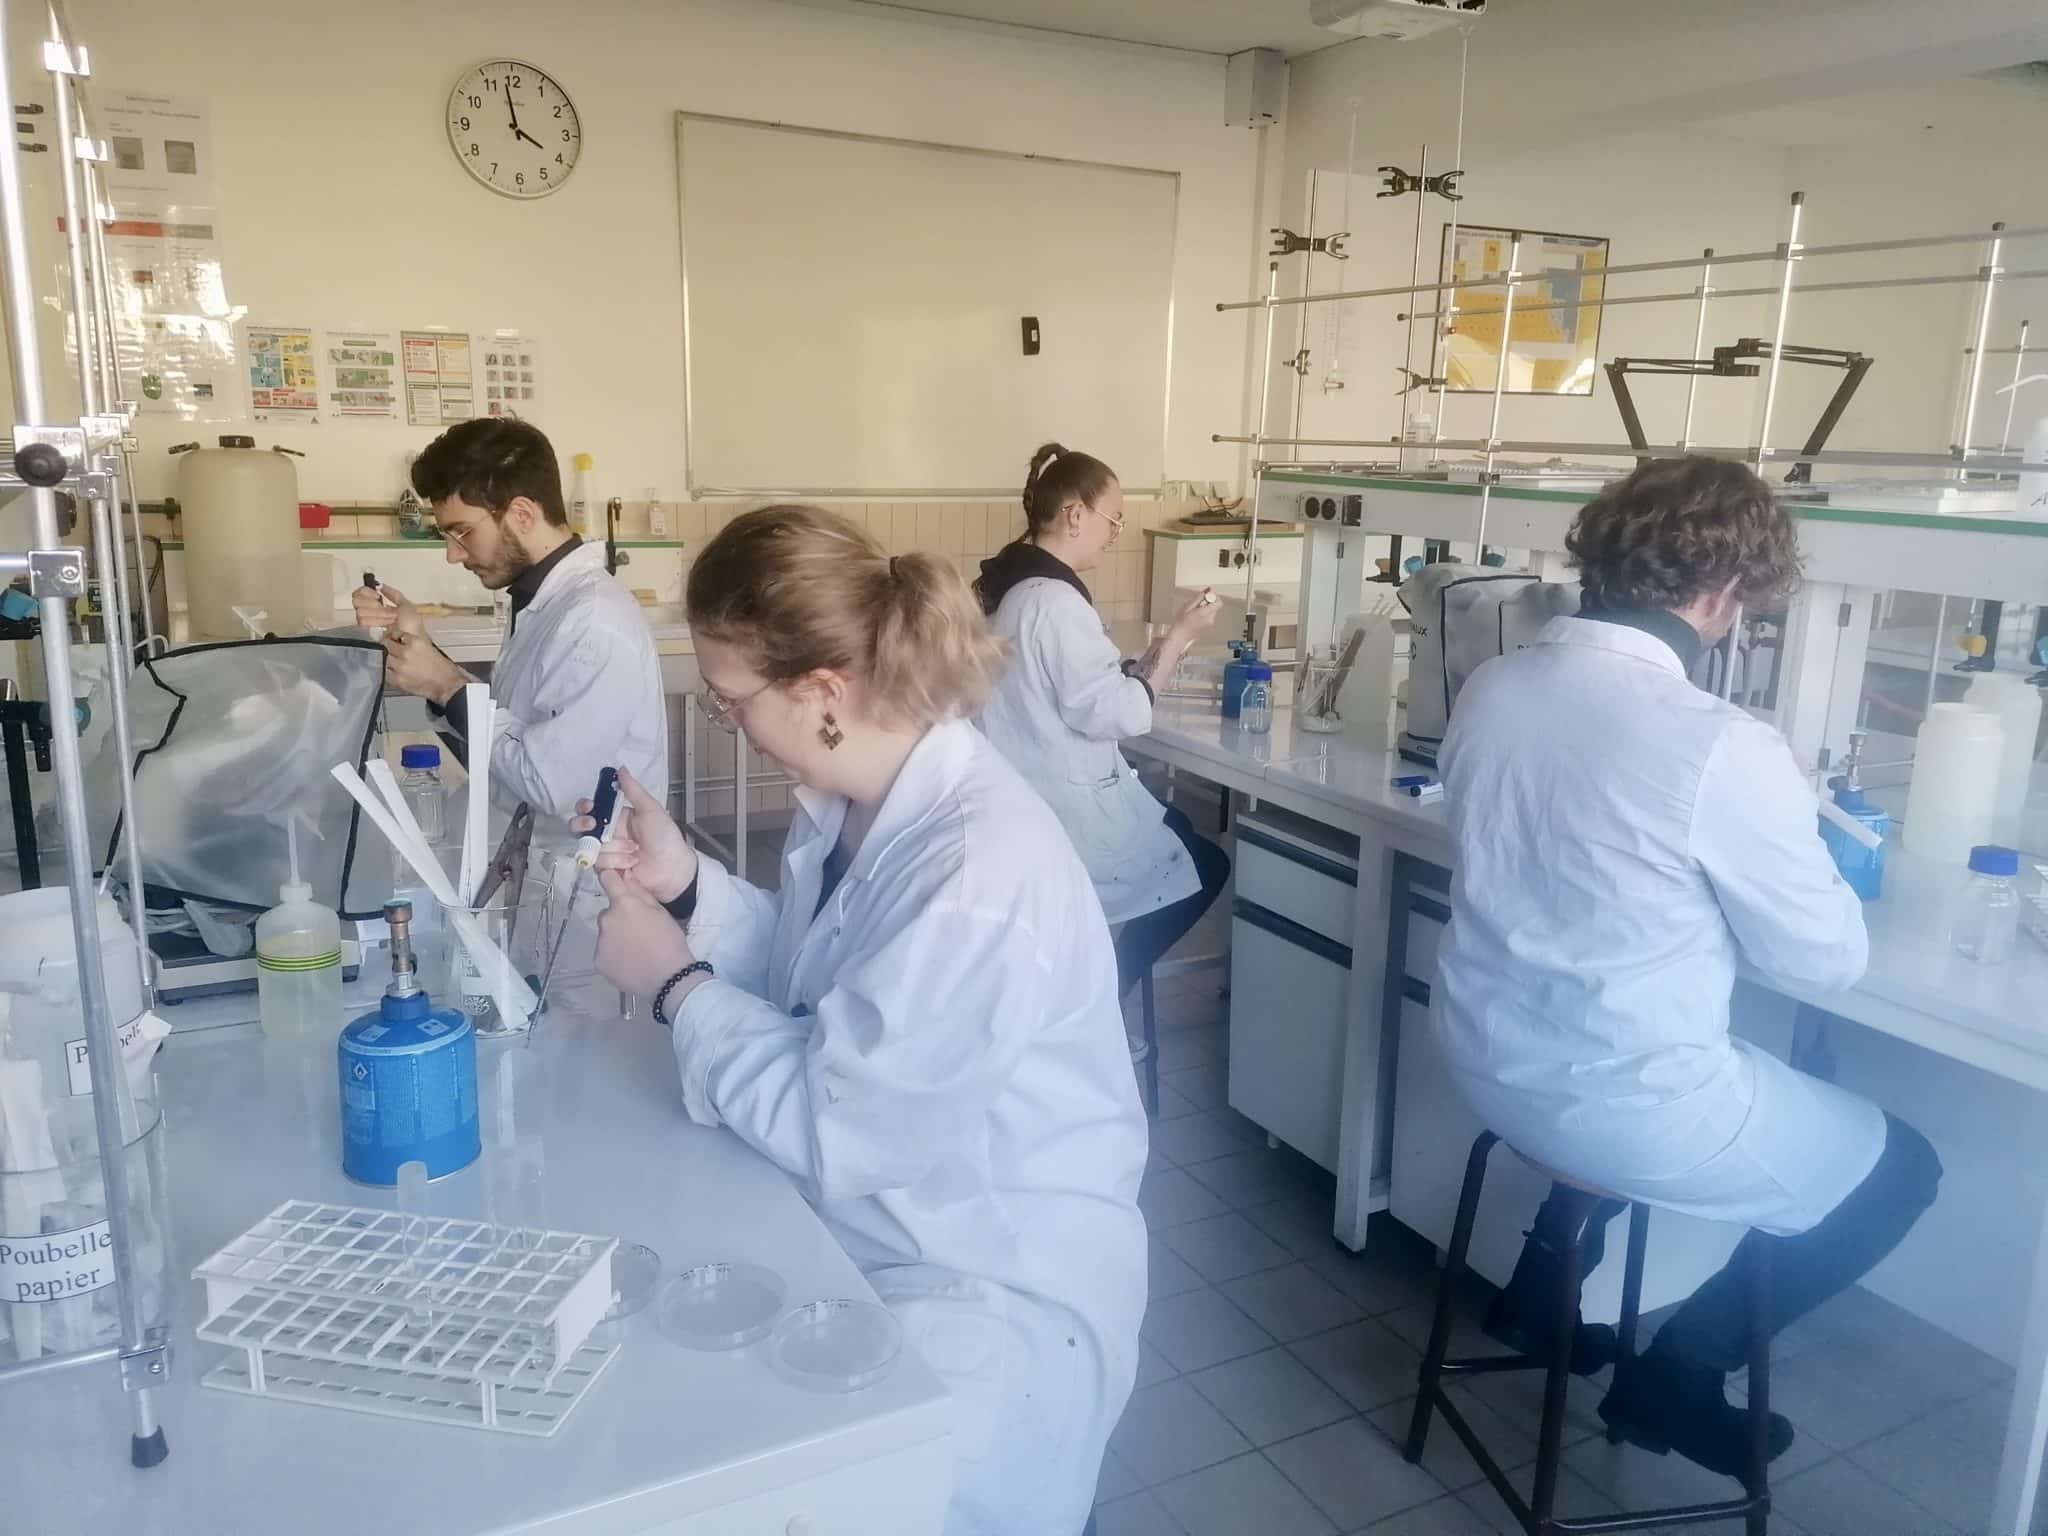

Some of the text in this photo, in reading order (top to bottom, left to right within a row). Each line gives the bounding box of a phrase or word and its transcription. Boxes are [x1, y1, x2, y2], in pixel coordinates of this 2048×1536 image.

[483, 78, 497, 92] 11
[504, 75, 521, 89] 12
[537, 85, 544, 98] 1
[467, 95, 482, 109] 10
[553, 105, 562, 118] 2
[460, 116, 470, 131] 9
[561, 129, 570, 142] 3
[471, 143, 480, 156] 8
[554, 152, 563, 164] 4
[490, 162, 498, 175] 7
[539, 167, 548, 180] 5
[515, 172, 524, 185] 6
[0, 1232, 112, 1265] Poubelle
[16, 1268, 101, 1302] papier
